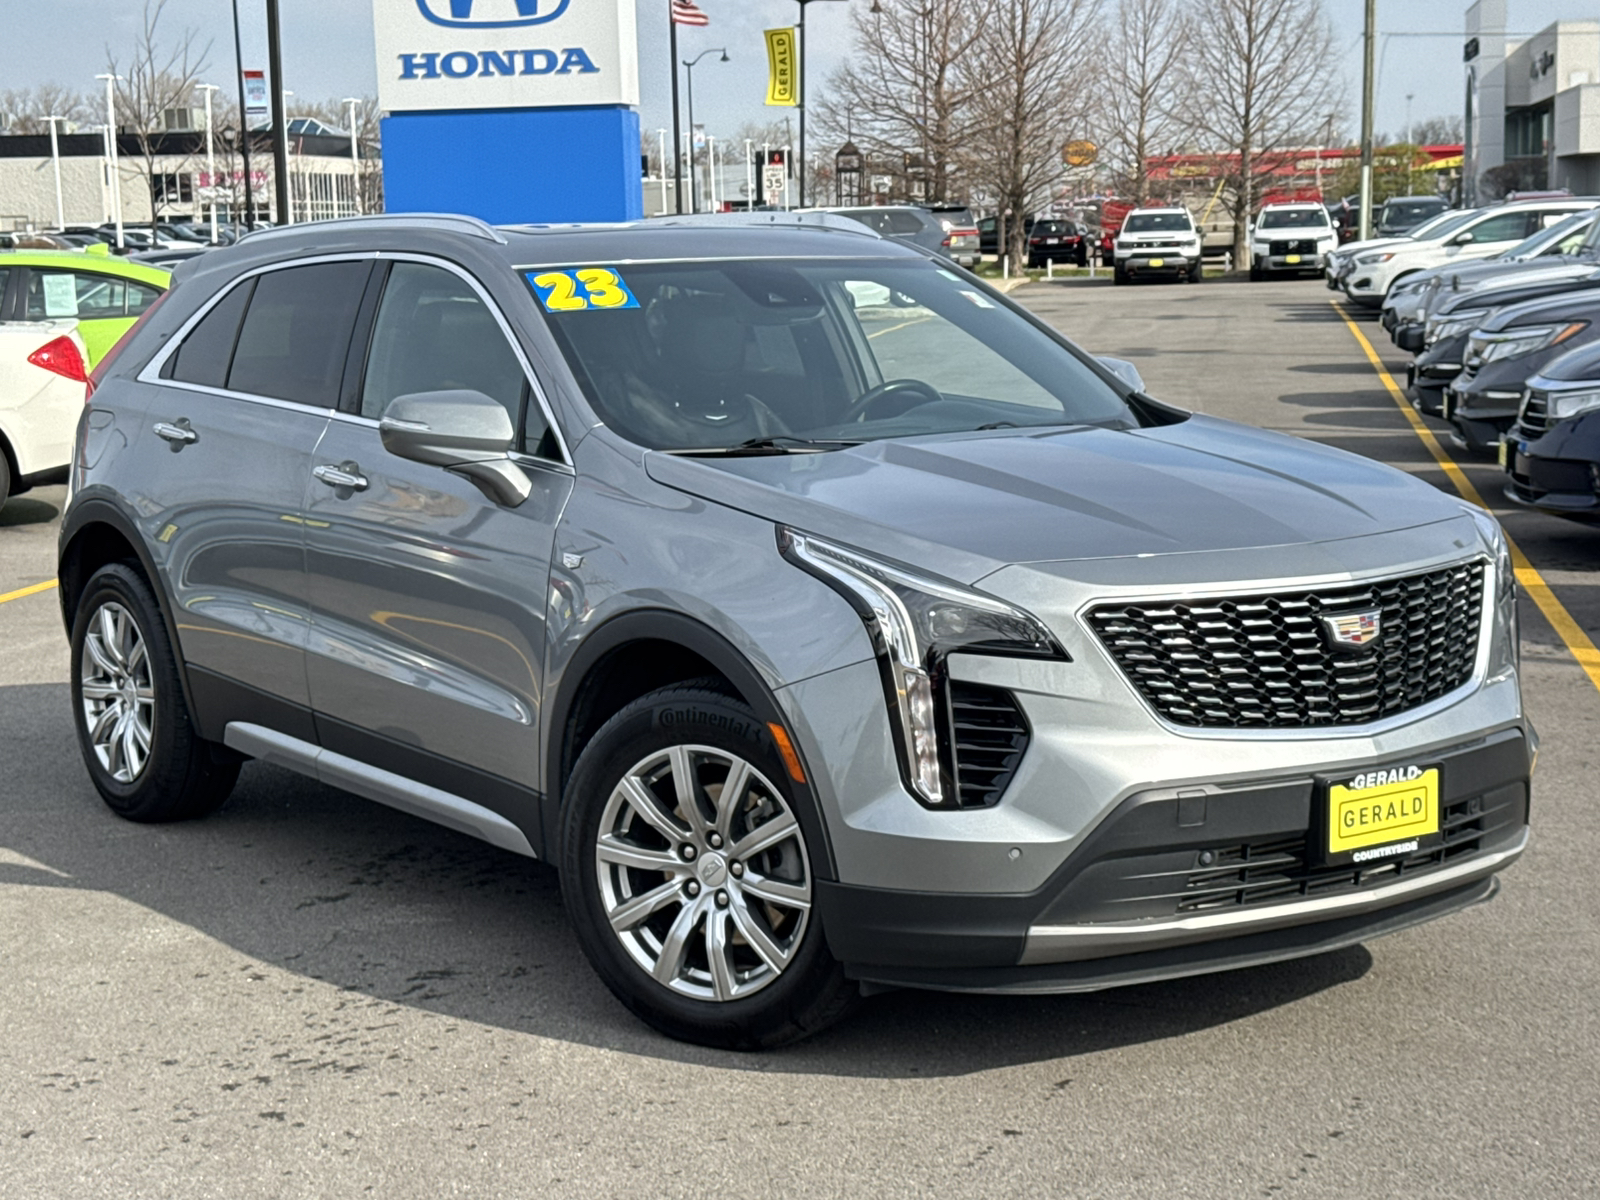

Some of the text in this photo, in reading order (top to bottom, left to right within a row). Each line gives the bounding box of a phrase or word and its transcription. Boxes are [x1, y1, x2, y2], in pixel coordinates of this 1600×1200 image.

[397, 47, 600, 80] HONDA
[776, 38, 788, 95] GERALD
[766, 178, 783, 189] 35
[534, 268, 628, 310] 23
[659, 706, 751, 738] Continental
[1353, 765, 1419, 790] GERALD
[1344, 797, 1422, 828] GERALD
[1353, 841, 1418, 862] COUNTRYSIDE
